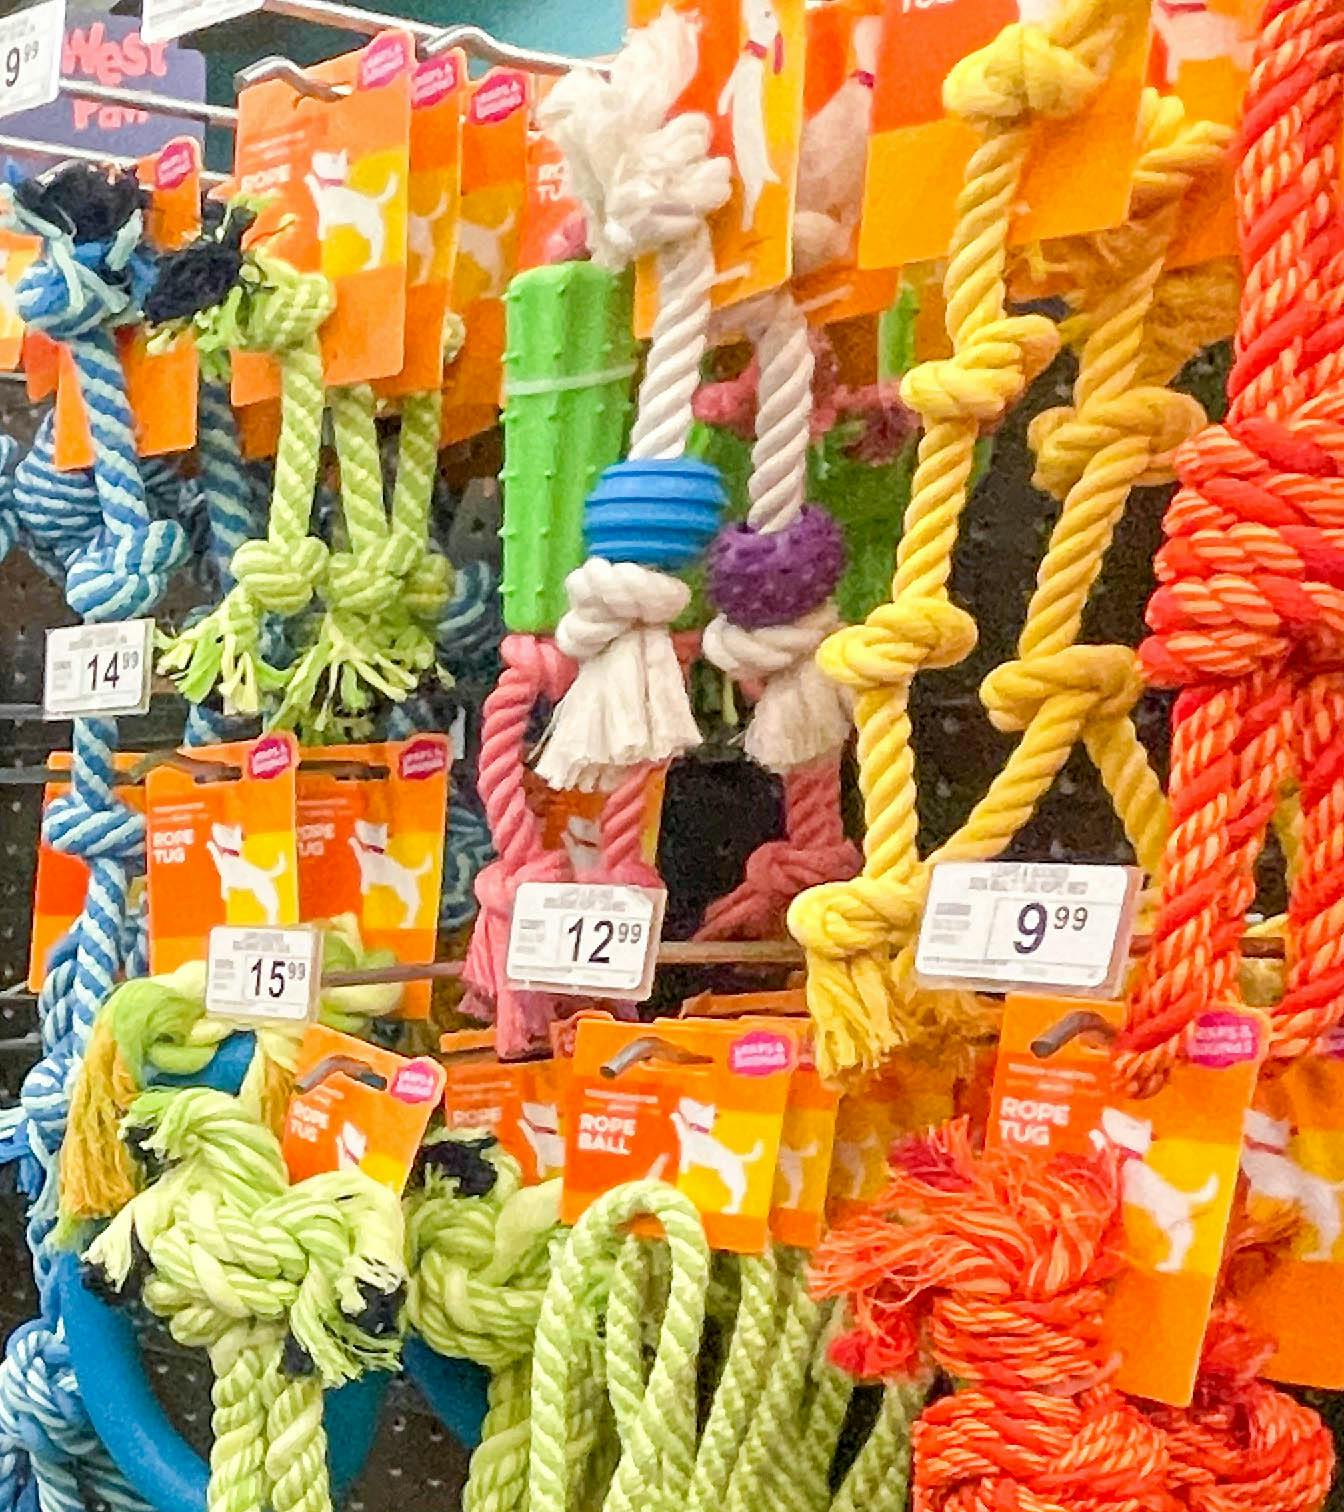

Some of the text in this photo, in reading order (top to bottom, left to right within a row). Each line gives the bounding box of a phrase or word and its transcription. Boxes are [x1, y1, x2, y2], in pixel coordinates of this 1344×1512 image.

[61, 22, 168, 85] West
[1000, 1097, 1071, 1126] ROPE
[579, 1113, 637, 1136] ROPE
[998, 1121, 1051, 1146] TUG
[578, 1132, 632, 1156] BALL
